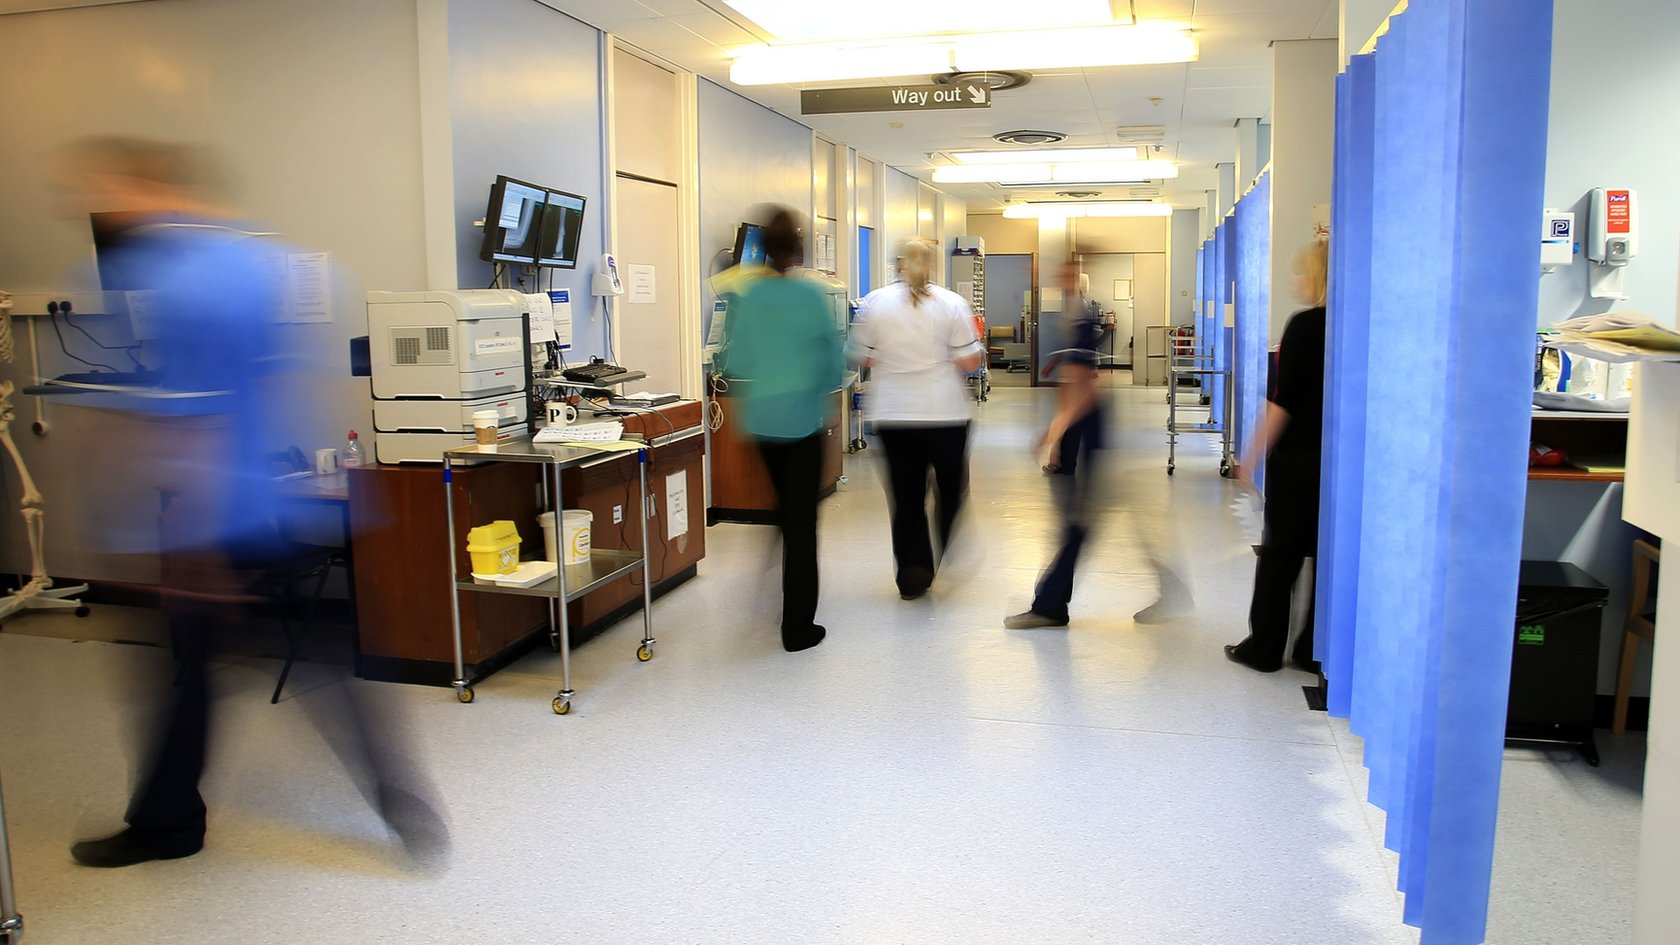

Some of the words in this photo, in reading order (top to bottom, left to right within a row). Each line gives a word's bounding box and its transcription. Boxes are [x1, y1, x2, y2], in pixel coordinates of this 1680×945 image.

[892, 89, 928, 106] Way
[933, 87, 962, 103] out
[549, 408, 561, 423] P
